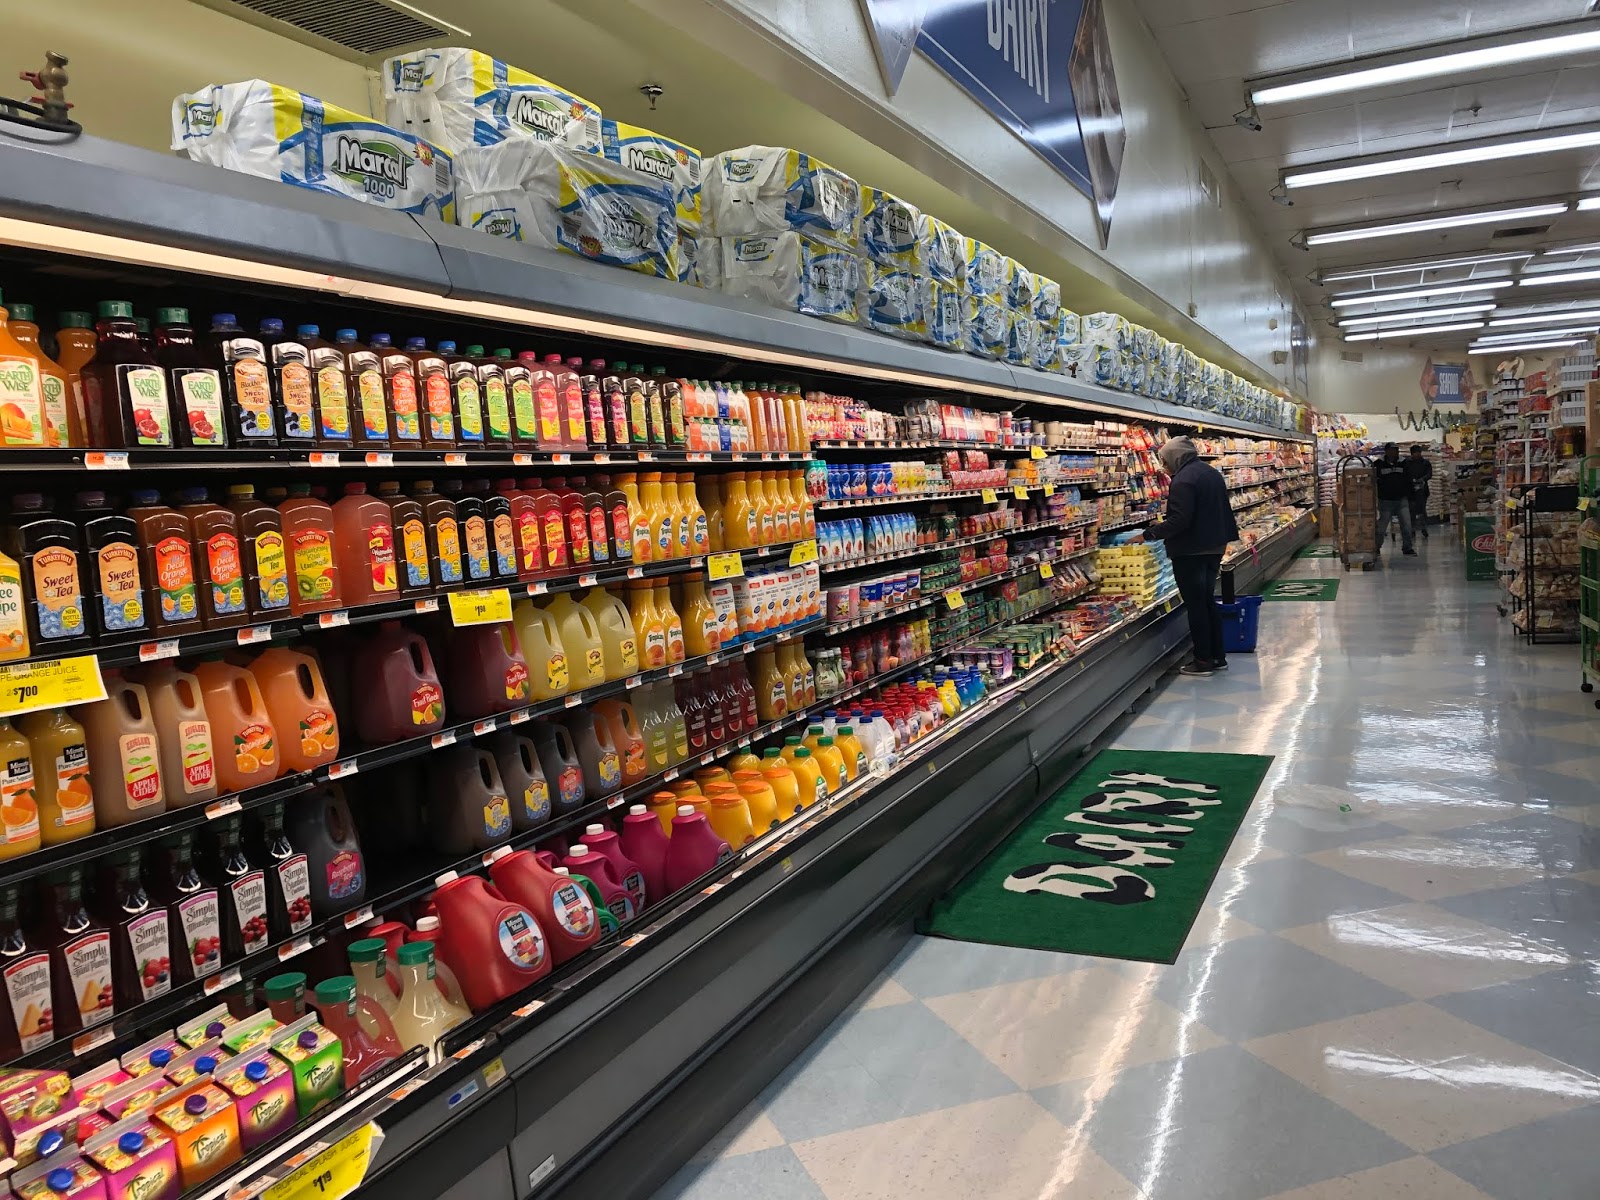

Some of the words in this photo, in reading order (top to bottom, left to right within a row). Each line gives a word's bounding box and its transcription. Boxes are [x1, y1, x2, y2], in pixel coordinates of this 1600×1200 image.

[517, 95, 569, 141] Marcal
[337, 133, 408, 189] Marcal
[628, 147, 675, 181] Marcal
[363, 178, 395, 198] 1000
[0, 371, 32, 382] EARTH
[134, 377, 161, 388] EARTH
[3, 381, 30, 392] WISE
[187, 380, 215, 391] EARTH
[1439, 372, 1459, 395] SEAFOOD
[139, 387, 160, 397] WISE
[191, 389, 214, 400] WISE
[38, 553, 61, 566] TURKEY
[61, 553, 72, 565] HILL
[103, 549, 122, 560] TURKEY
[122, 549, 134, 559] HILL
[217, 555, 234, 566] Decaf
[258, 551, 283, 565] Lemonade
[166, 560, 186, 572] Decaf
[212, 562, 237, 575] Orange
[270, 561, 279, 570] Tea
[300, 559, 329, 571] Lemonade
[107, 568, 135, 583] Sweet
[161, 568, 188, 581] Orange
[218, 573, 230, 582] Tea
[43, 573, 74, 589] Sweet
[119, 580, 134, 591] Tea
[167, 577, 180, 587] Tea
[56, 585, 73, 598] Tea
[30, 661, 61, 669] REDUCTION
[53, 666, 77, 676] JUICE
[507, 674, 517, 684] Fruit
[413, 696, 426, 708] Fruit
[66, 746, 85, 756] Minute
[69, 752, 84, 760] Maid
[10, 760, 29, 770] Minute
[14, 766, 28, 775] Maid
[189, 764, 210, 776] APPLE
[189, 771, 211, 783] CIDER
[133, 777, 156, 791] APPLE
[133, 785, 157, 798] CIDER
[1003, 770, 1222, 905] DAIRY
[284, 864, 307, 883] Simply
[238, 882, 263, 902] Simply
[186, 901, 216, 923] Simply
[135, 920, 166, 944] Simply
[73, 943, 107, 968] Simply
[13, 965, 47, 991] Simply
[271, 1169, 310, 1194] TROPICAL
[309, 1149, 338, 1170] SPLASH
[339, 1133, 361, 1152] JUICE
